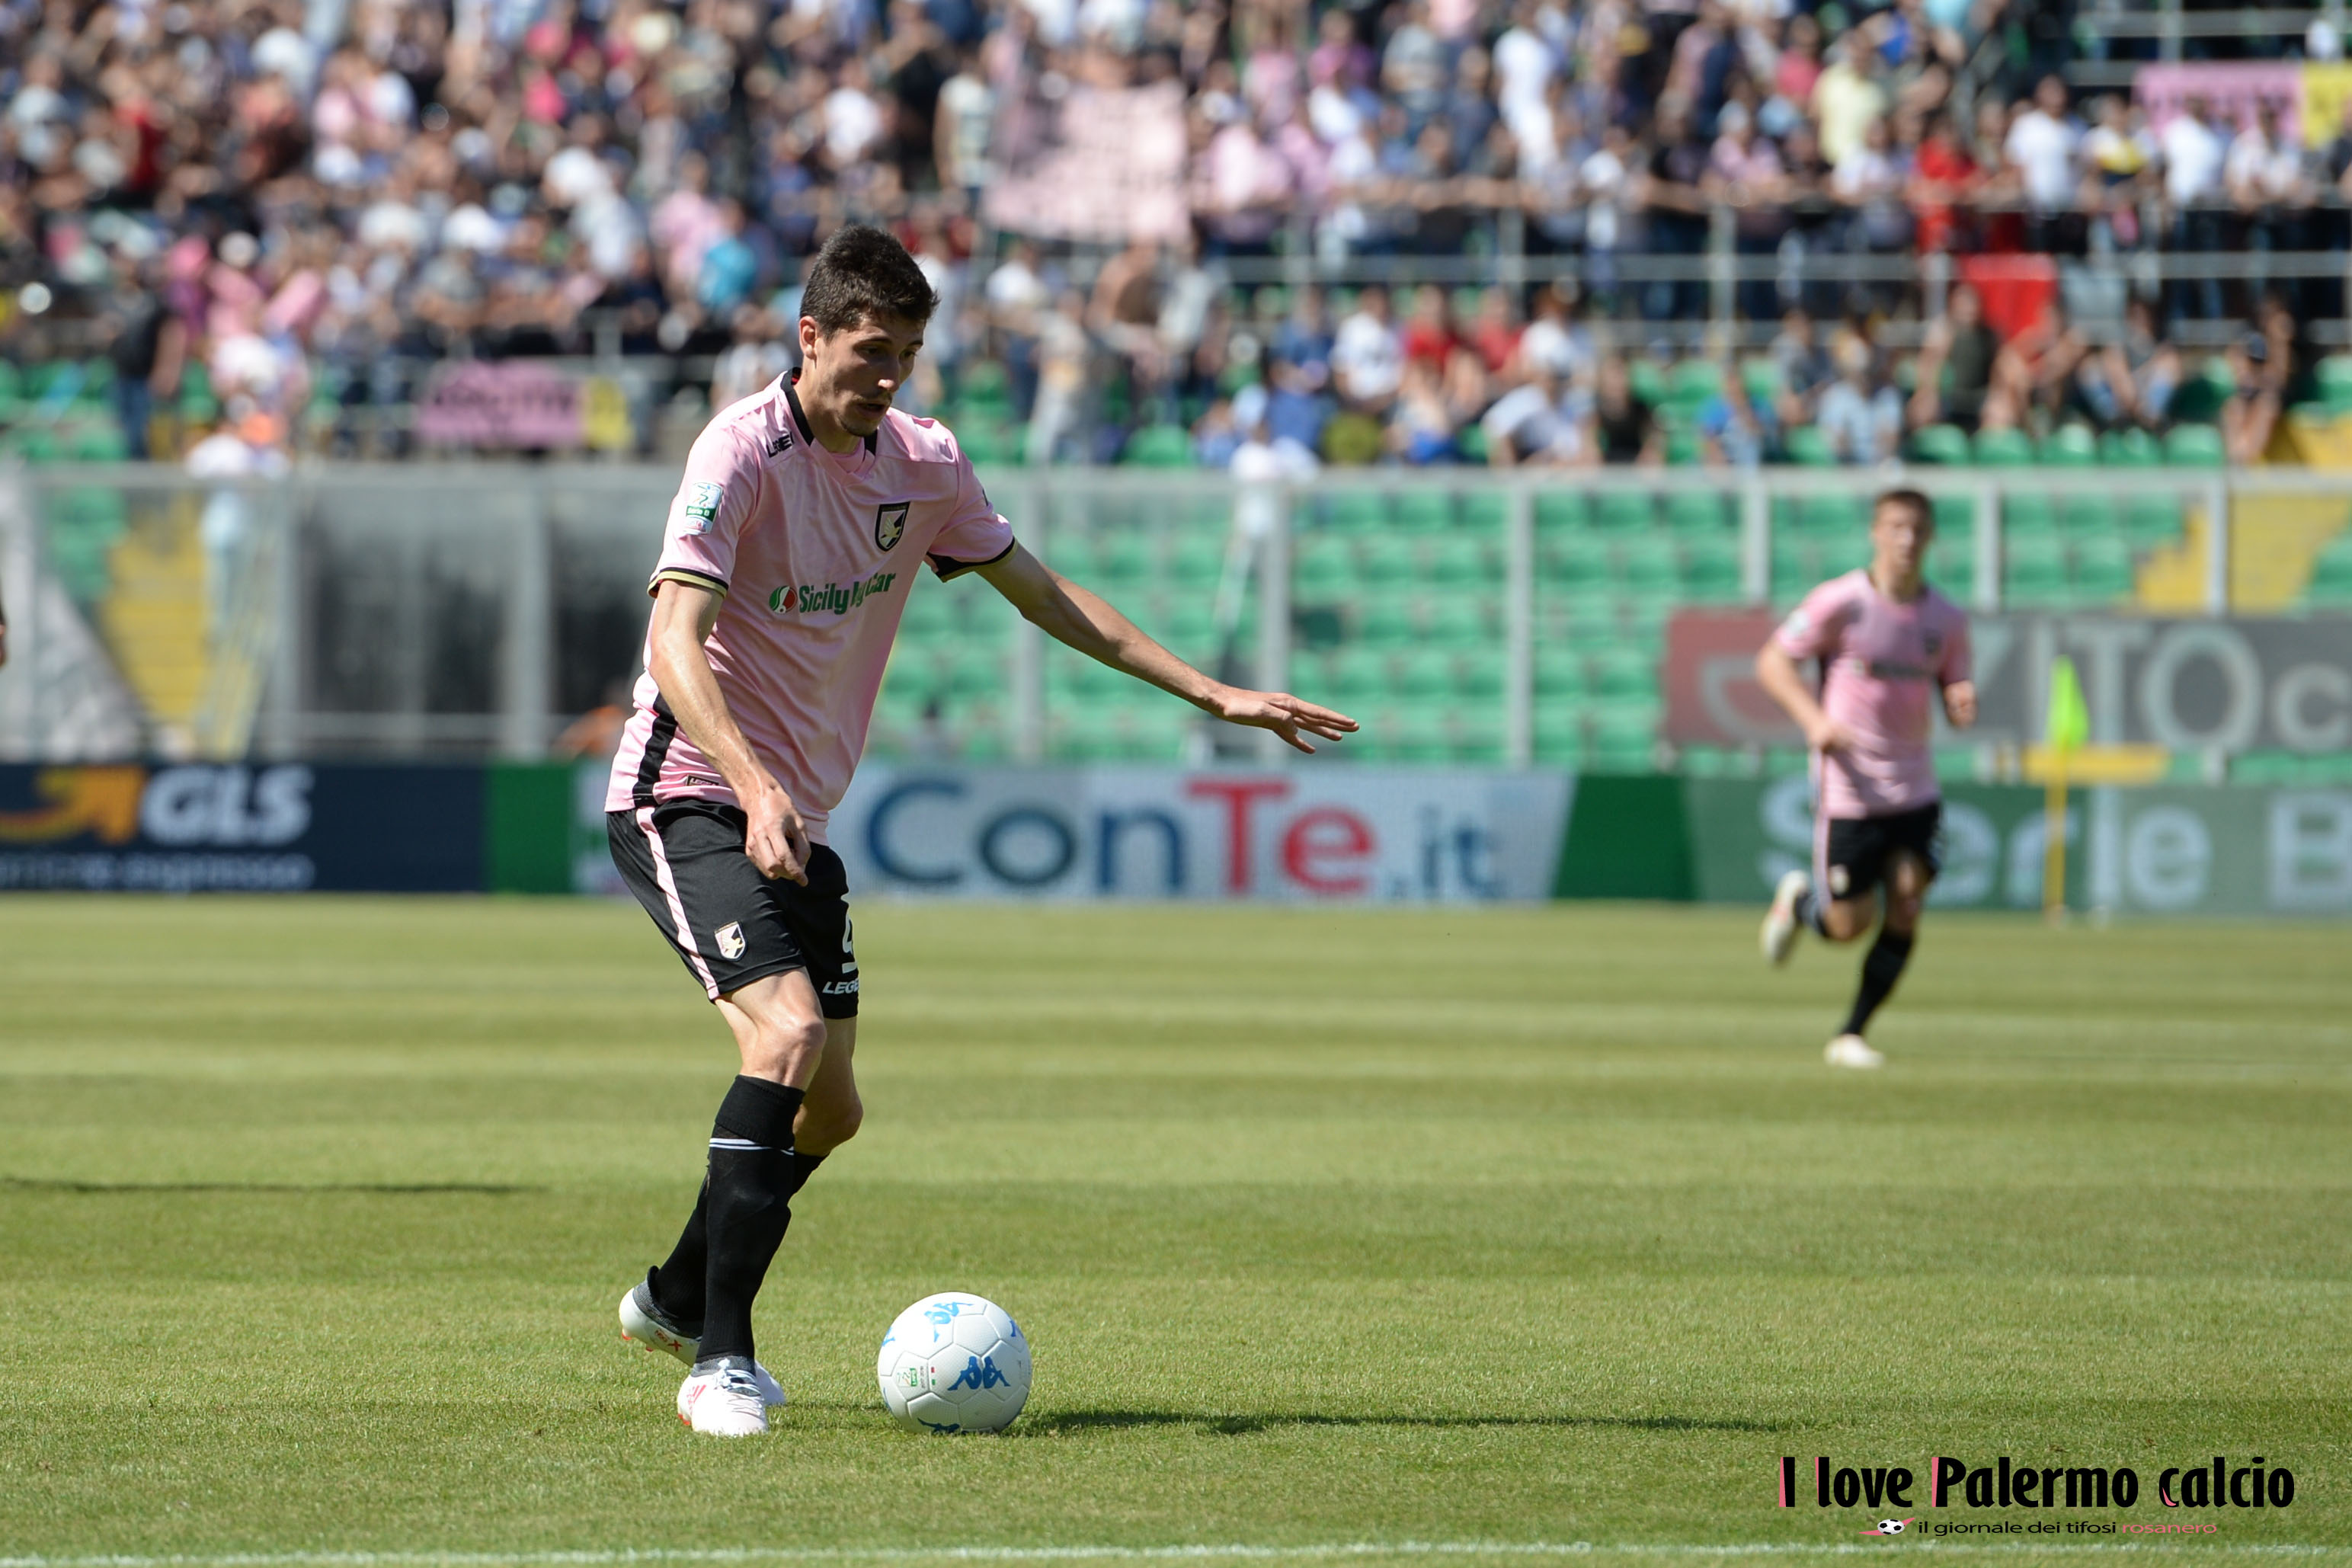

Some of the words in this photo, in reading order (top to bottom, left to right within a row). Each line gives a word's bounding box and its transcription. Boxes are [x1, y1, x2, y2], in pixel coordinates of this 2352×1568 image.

[799, 583, 850, 615] Sicily
[866, 573, 896, 597] Car
[142, 764, 313, 846] GLS
